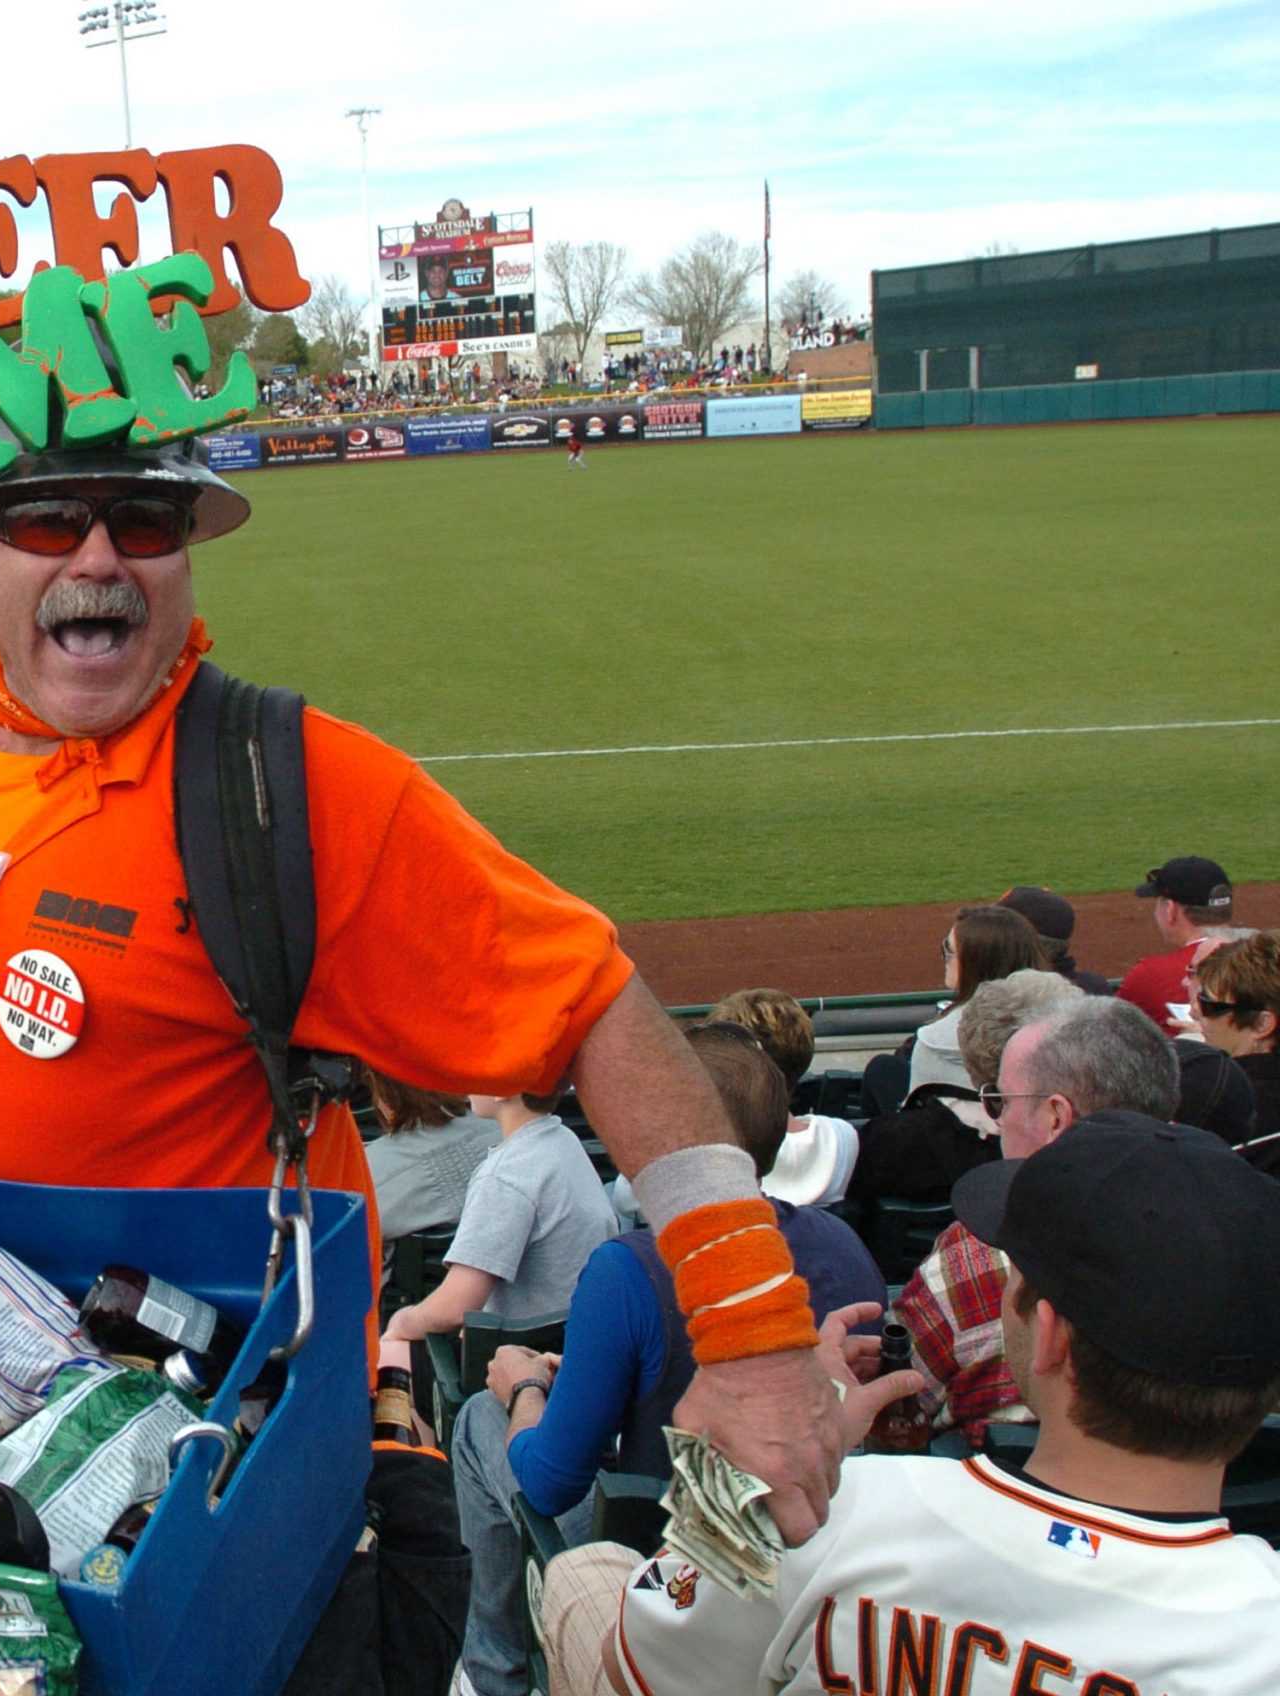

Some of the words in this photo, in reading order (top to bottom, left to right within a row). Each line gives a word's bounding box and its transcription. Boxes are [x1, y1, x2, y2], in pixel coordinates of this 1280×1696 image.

[421, 217, 485, 237] SCOTTSDALE
[455, 273, 484, 288] BELT
[461, 341, 491, 353] See's
[492, 339, 532, 351] CANDIES
[643, 402, 702, 416] SHOTGUN
[267, 437, 316, 455] Valley
[19, 955, 38, 975] NO
[39, 966, 73, 994] SALE.
[3, 972, 35, 1008] NO
[35, 990, 70, 1029] I.D.
[6, 1008, 26, 1029] NO
[26, 1018, 58, 1048] WAY.
[814, 1595, 1143, 1696] LINCE
